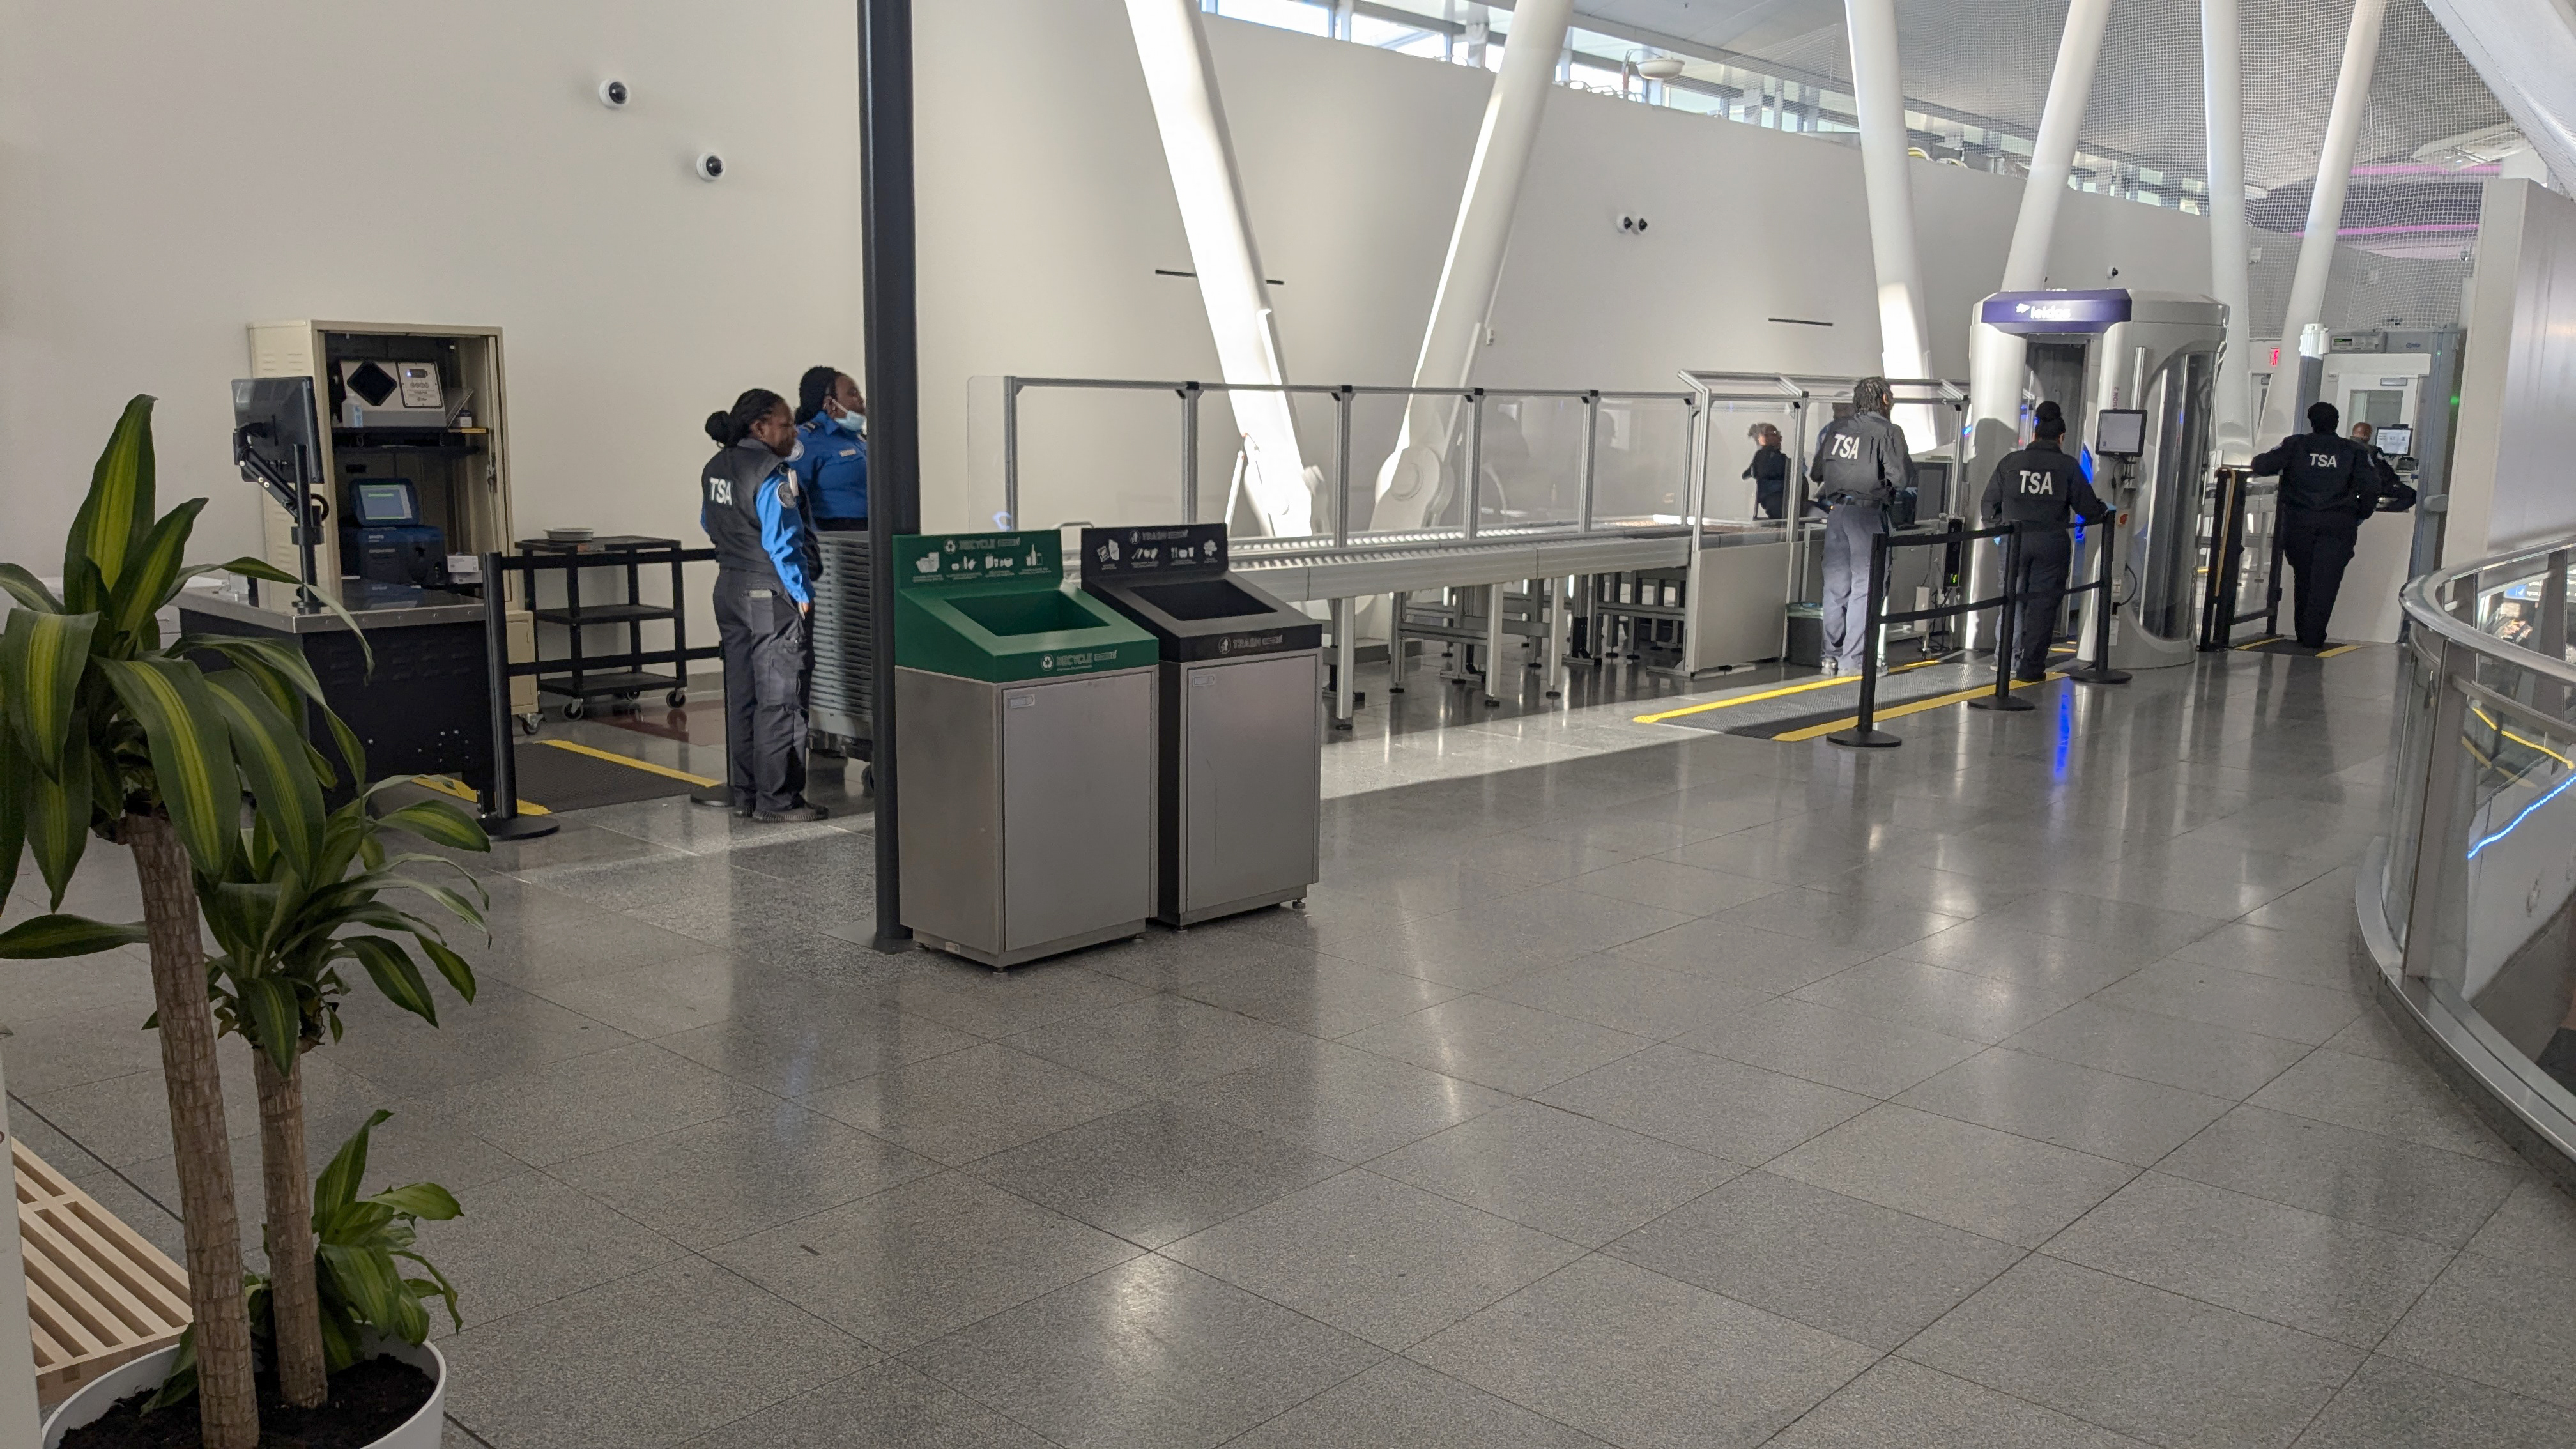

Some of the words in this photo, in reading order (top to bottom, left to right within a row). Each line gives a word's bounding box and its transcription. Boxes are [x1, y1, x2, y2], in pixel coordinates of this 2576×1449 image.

[2030, 305, 2071, 319] leidos
[1831, 434, 1860, 460] TSA
[2310, 453, 2337, 468] TSA
[709, 477, 733, 505] TSA
[2020, 470, 2053, 495] TSA
[1056, 652, 1093, 666] RECYCLE
